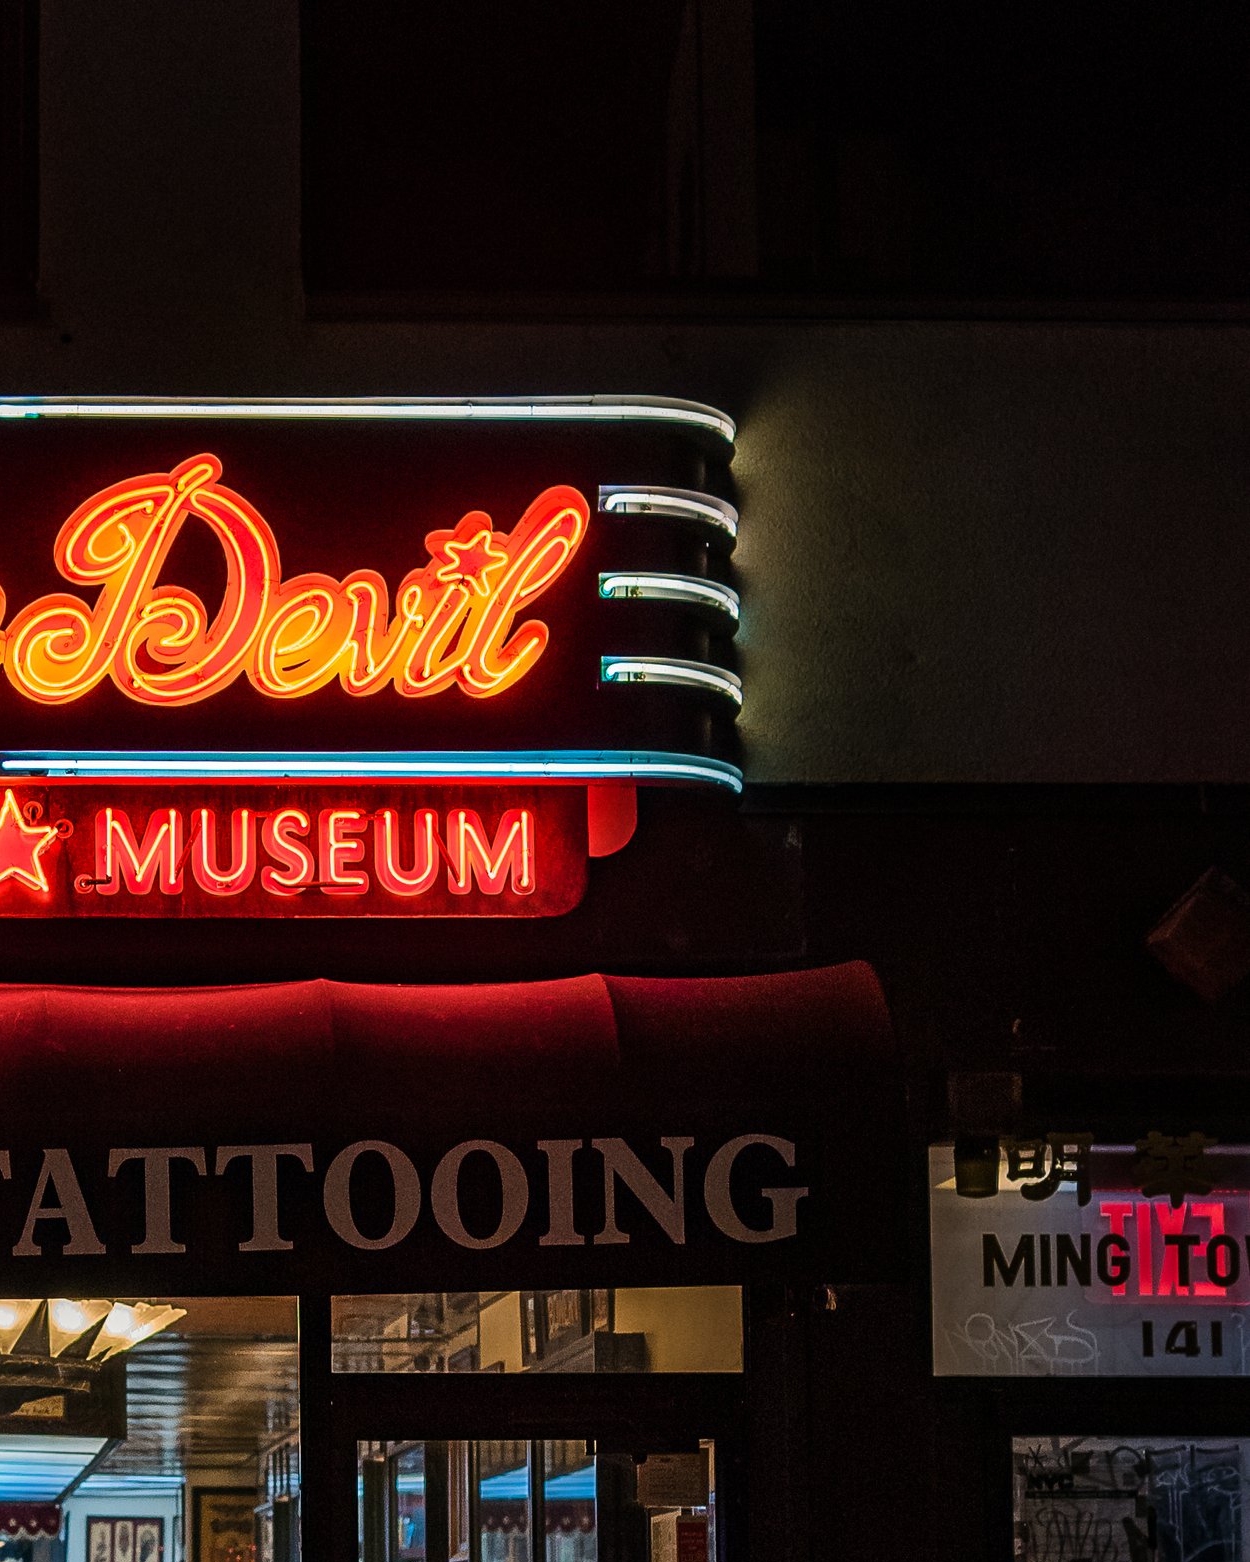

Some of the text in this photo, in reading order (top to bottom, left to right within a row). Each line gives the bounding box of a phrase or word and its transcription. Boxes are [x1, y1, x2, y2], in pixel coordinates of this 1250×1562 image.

[92, 806, 538, 897] MUSEUM
[982, 1233, 1250, 1287] MING TO
[1142, 1320, 1223, 1358] 141
